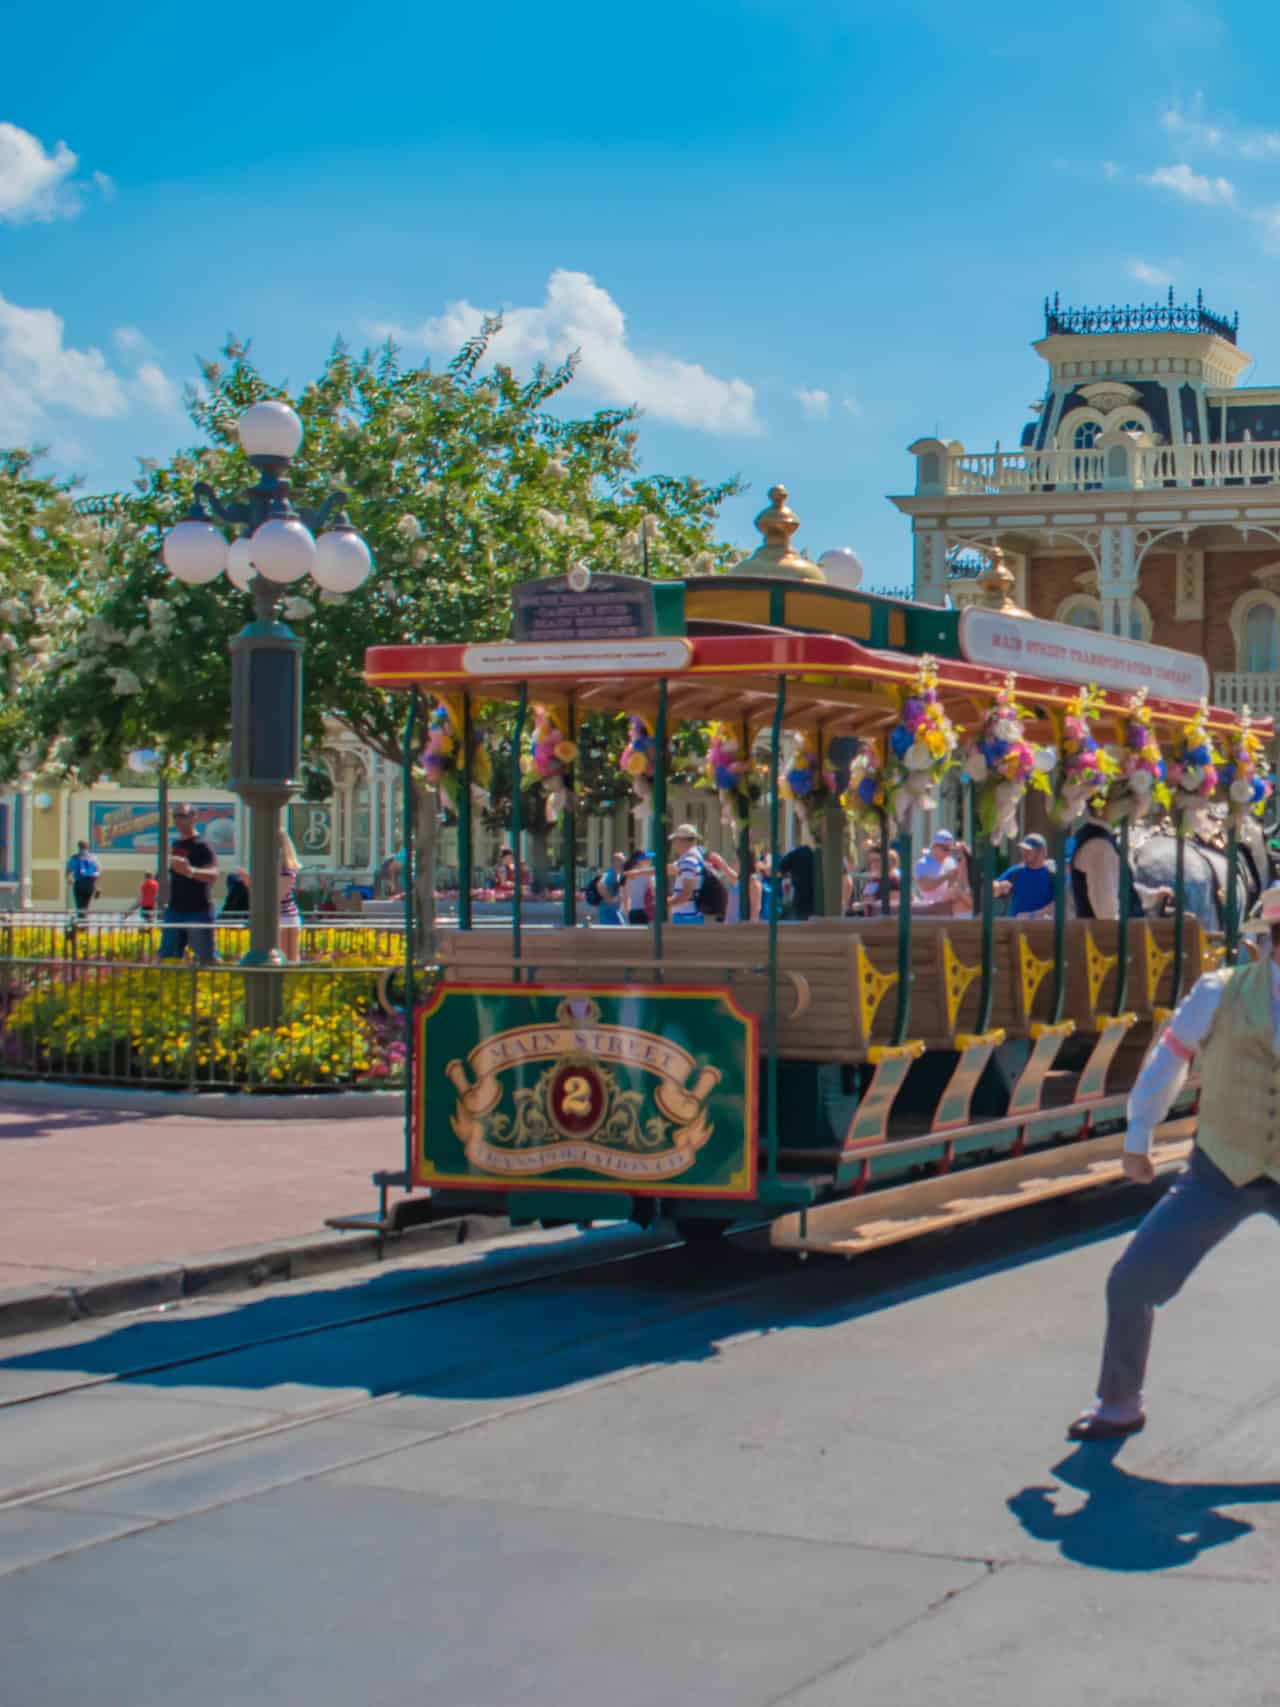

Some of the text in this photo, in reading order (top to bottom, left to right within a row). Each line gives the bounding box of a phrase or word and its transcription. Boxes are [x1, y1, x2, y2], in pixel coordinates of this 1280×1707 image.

[489, 1030, 673, 1067] MAIN STREET
[561, 1076, 592, 1116] 2
